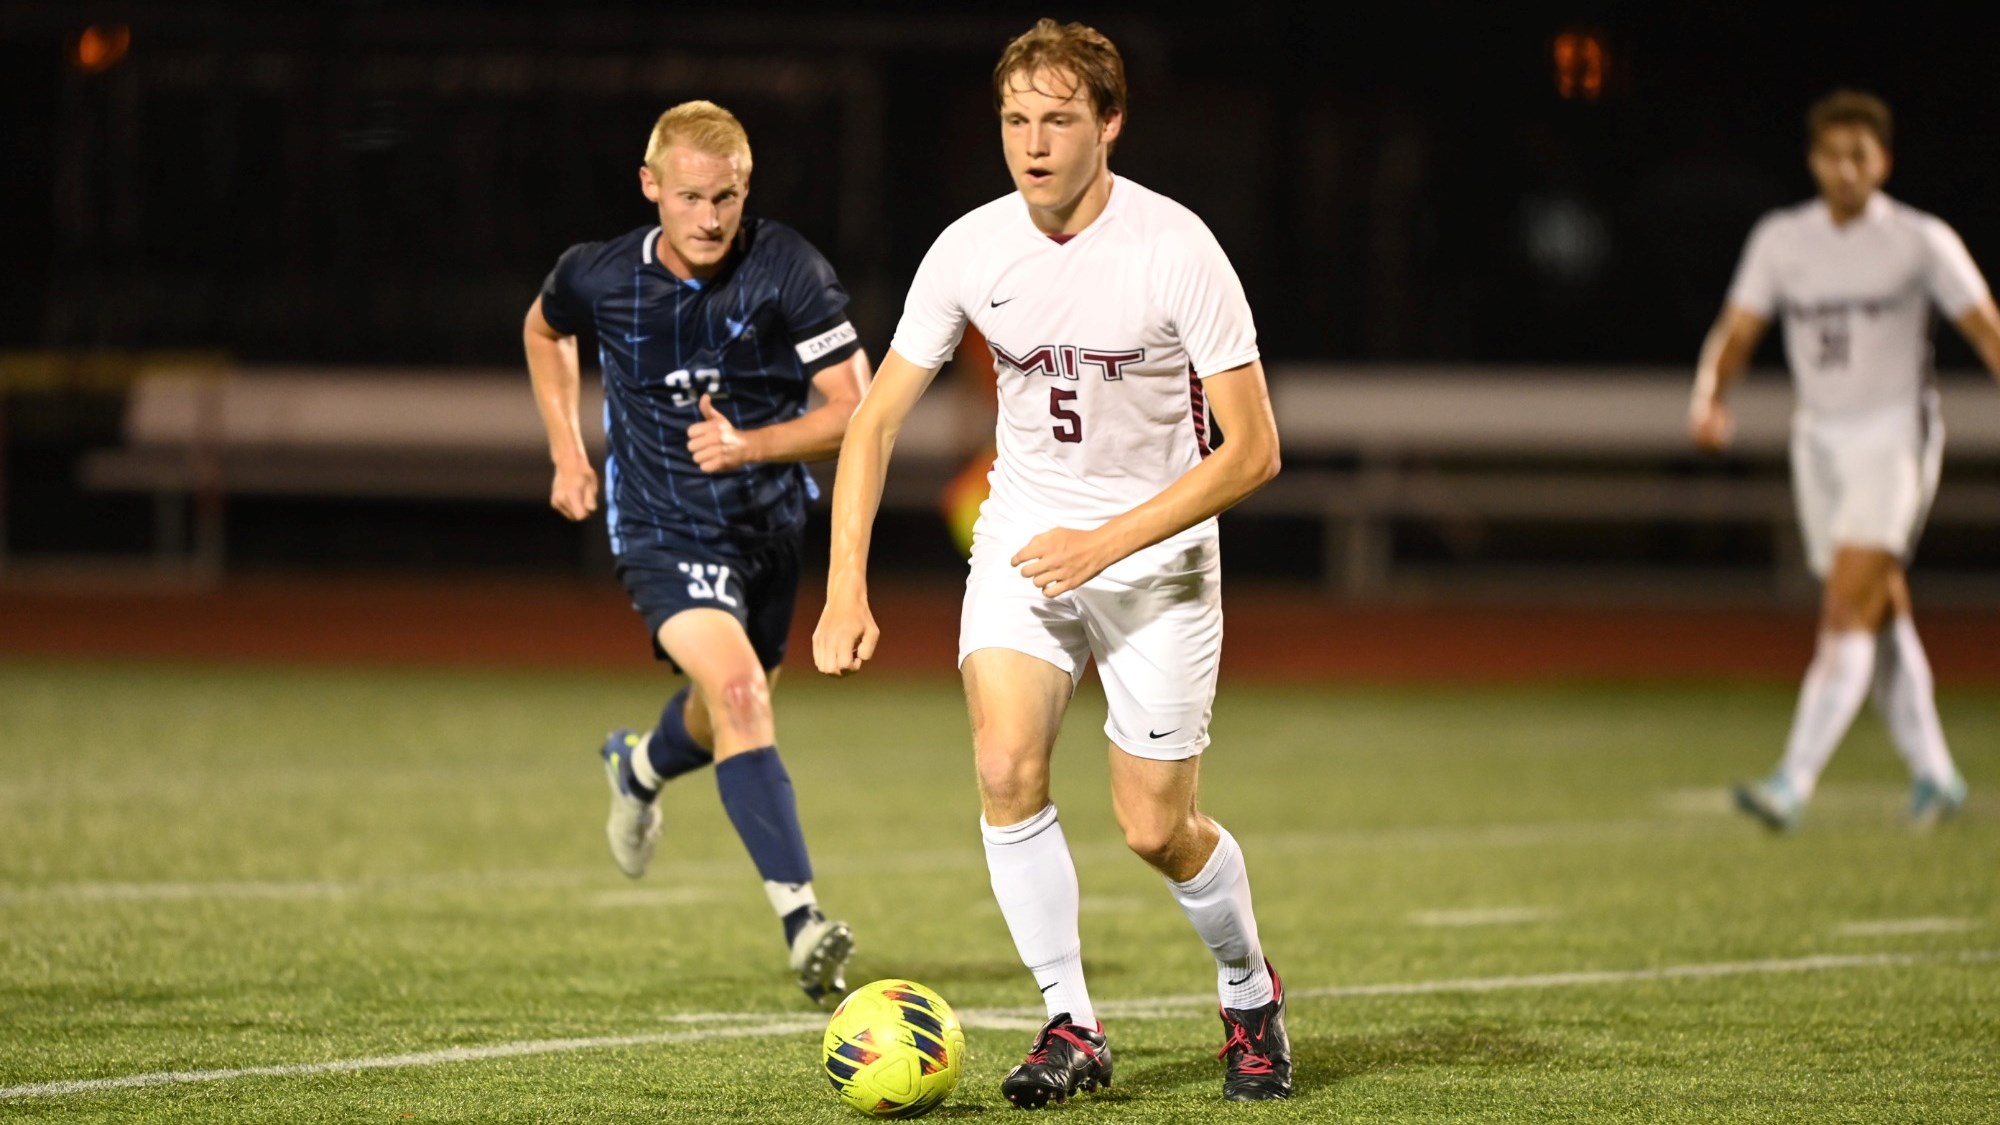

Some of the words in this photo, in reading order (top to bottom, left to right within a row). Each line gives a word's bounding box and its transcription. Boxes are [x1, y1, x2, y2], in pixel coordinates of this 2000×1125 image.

[808, 327, 857, 354] CAPTA
[987, 340, 1145, 381] MIT
[664, 368, 729, 407] 32
[1050, 386, 1083, 443] 5
[677, 561, 738, 608] 32
